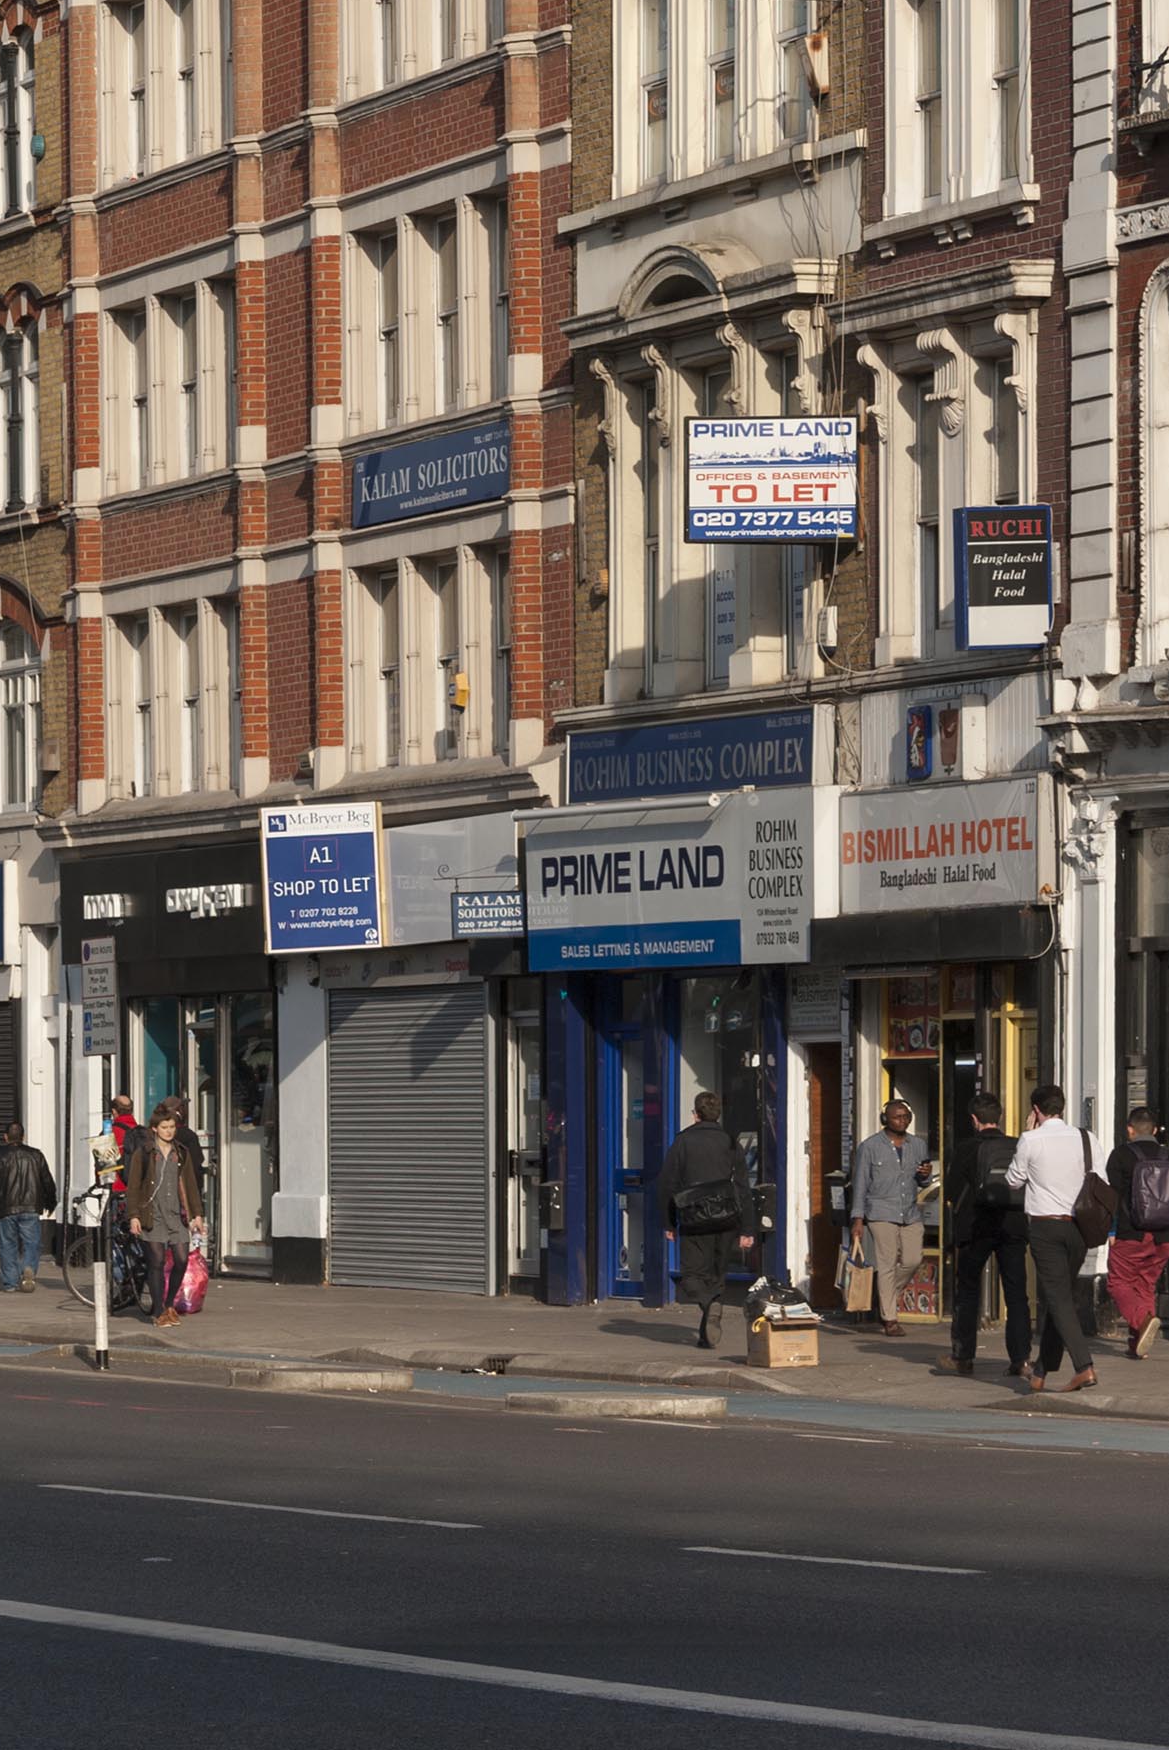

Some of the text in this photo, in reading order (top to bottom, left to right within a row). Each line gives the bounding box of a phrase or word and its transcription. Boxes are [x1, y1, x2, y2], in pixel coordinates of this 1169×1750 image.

[694, 422, 852, 438] PRIME LAND
[361, 445, 508, 503] KALAM SOLICITORS
[696, 472, 752, 481] OFFICES
[772, 471, 849, 480] BASEMENT
[708, 483, 837, 503] TO LET
[693, 510, 853, 527] 020 7377 5445
[705, 528, 845, 538] www.primelandproperty.co.uk
[970, 519, 1043, 537] RUCHI
[973, 552, 1043, 566] Bangladeshi
[992, 569, 1026, 581] Halal
[994, 586, 1025, 597] Food
[574, 738, 804, 792] ROHIM BUSINESS COMPLEX
[289, 810, 370, 827] McBryer Beg
[756, 819, 797, 843] ROHIM
[842, 816, 1033, 865] BISMILLAH HOTEL
[310, 846, 333, 864] A1
[749, 846, 803, 871] BUSINESS
[541, 845, 724, 897] PRIME LAND
[880, 862, 996, 890] Bangladeshi Halal Food
[273, 877, 371, 897] SHOP TO LET
[748, 874, 803, 899] COMPLEX
[458, 895, 520, 906] KALAM
[299, 908, 319, 918] 0207
[321, 907, 336, 916] 702
[458, 907, 521, 919] SOLICITORS
[561, 939, 715, 959] SALES LETTING & MANAGEMENT
